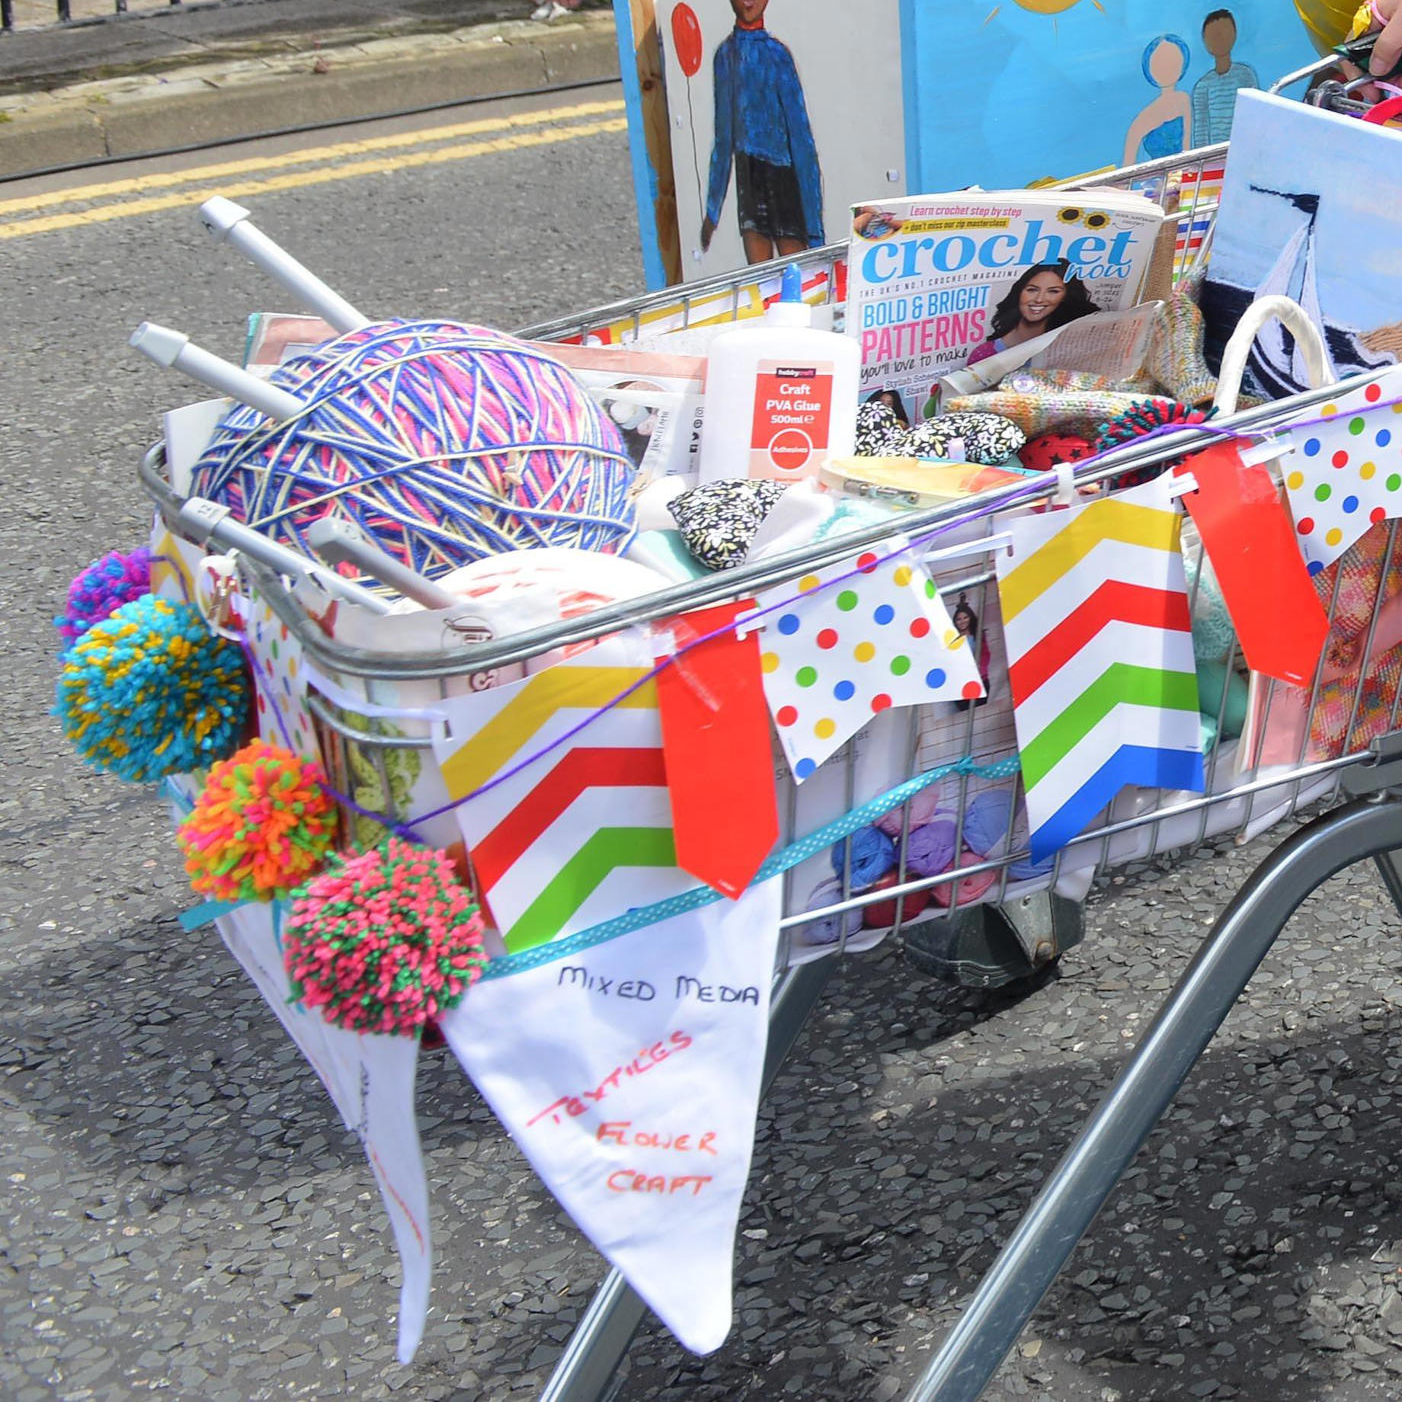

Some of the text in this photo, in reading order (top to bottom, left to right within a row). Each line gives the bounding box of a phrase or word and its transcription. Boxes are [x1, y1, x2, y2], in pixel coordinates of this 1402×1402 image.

[910, 205, 1022, 218] Learn crochet step by step
[862, 220, 1139, 284] crochet
[880, 284, 899, 295] UK'S
[904, 280, 924, 290] NO.1
[928, 274, 967, 286] CROCHET
[972, 270, 1018, 281] MAGAZINE
[1063, 262, 1131, 284] now
[863, 285, 991, 328] BOLD & BRIGHT
[861, 308, 986, 365] PATTERNS
[860, 348, 968, 384] you'll love to make
[779, 383, 811, 395] Craft
[766, 399, 821, 411] PVA Glue
[557, 965, 760, 1006] MIXED MEDIA
[595, 1121, 718, 1156] FLOWER
[606, 1169, 713, 1196] CRAFT
